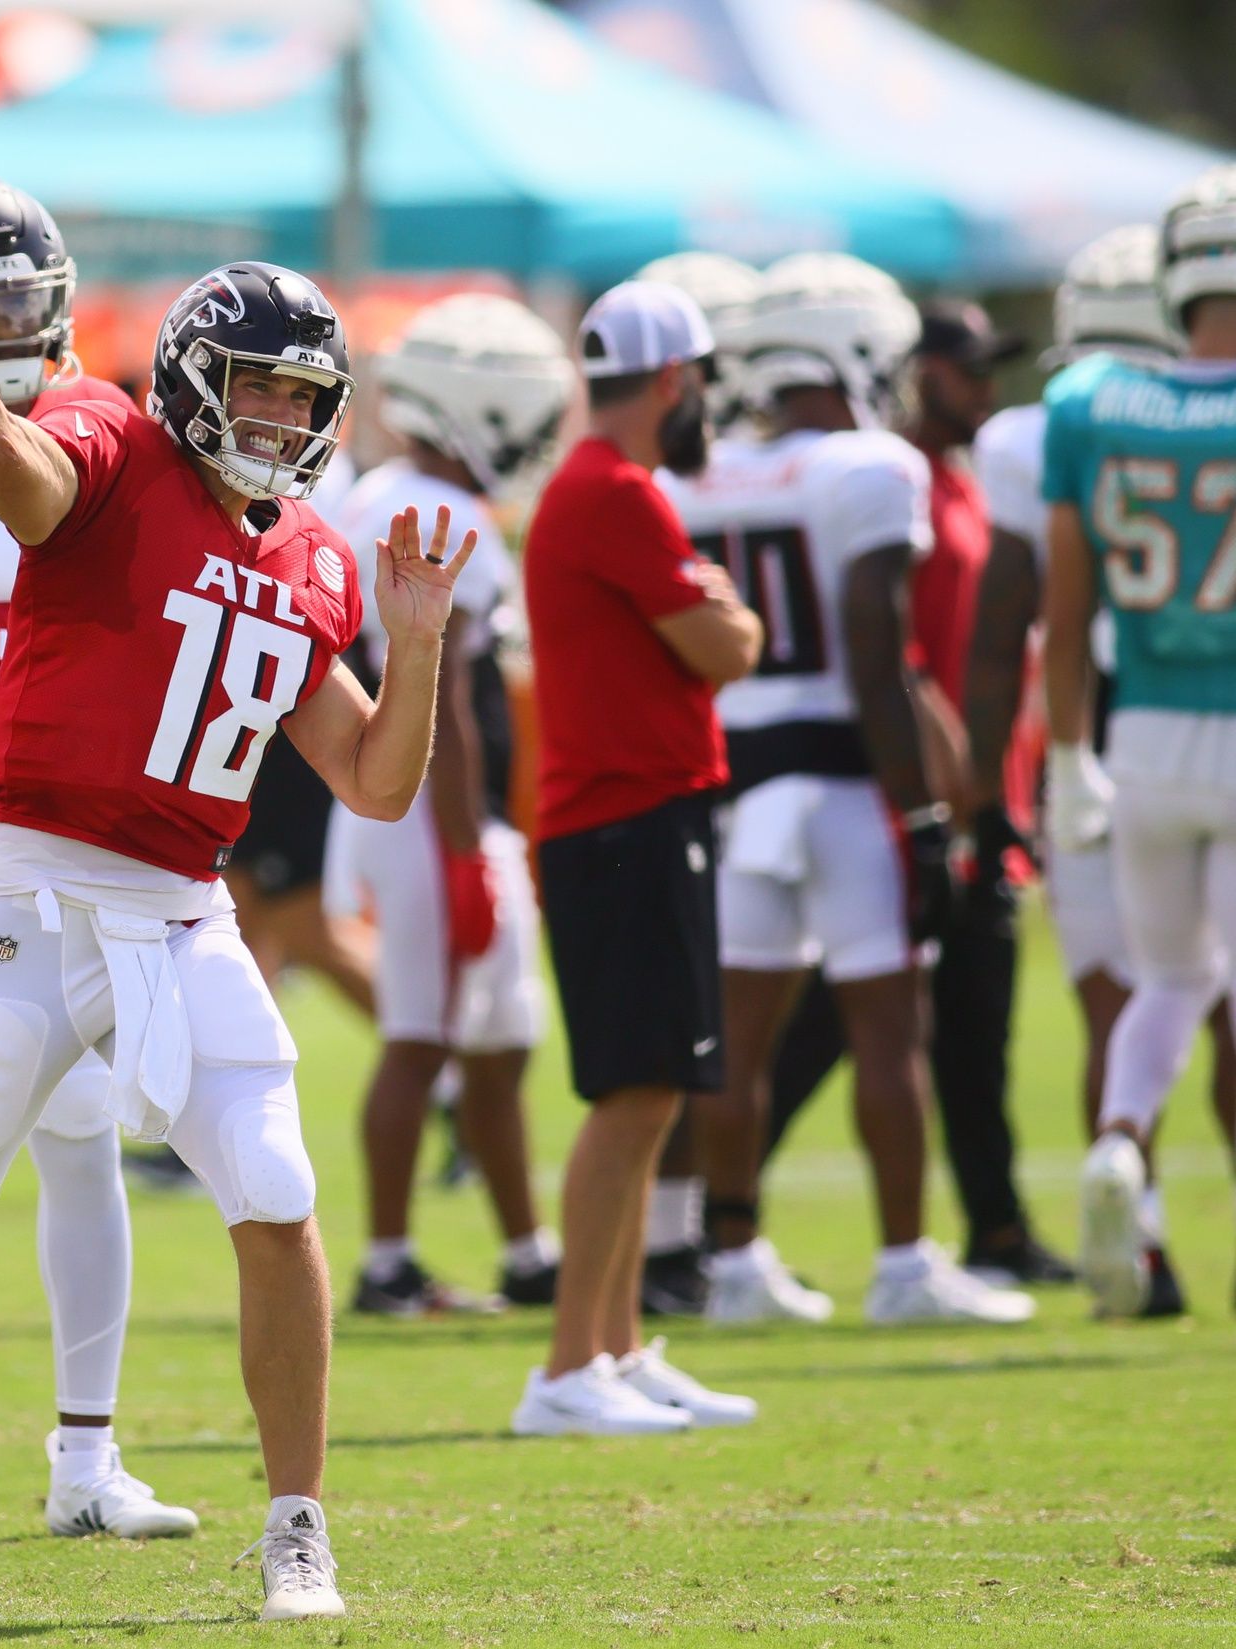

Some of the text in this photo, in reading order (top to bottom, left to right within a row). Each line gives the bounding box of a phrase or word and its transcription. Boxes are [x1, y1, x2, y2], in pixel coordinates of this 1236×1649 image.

[194, 552, 306, 626] ATL
[143, 588, 313, 802] 18
[291, 1520, 314, 1529] didas
